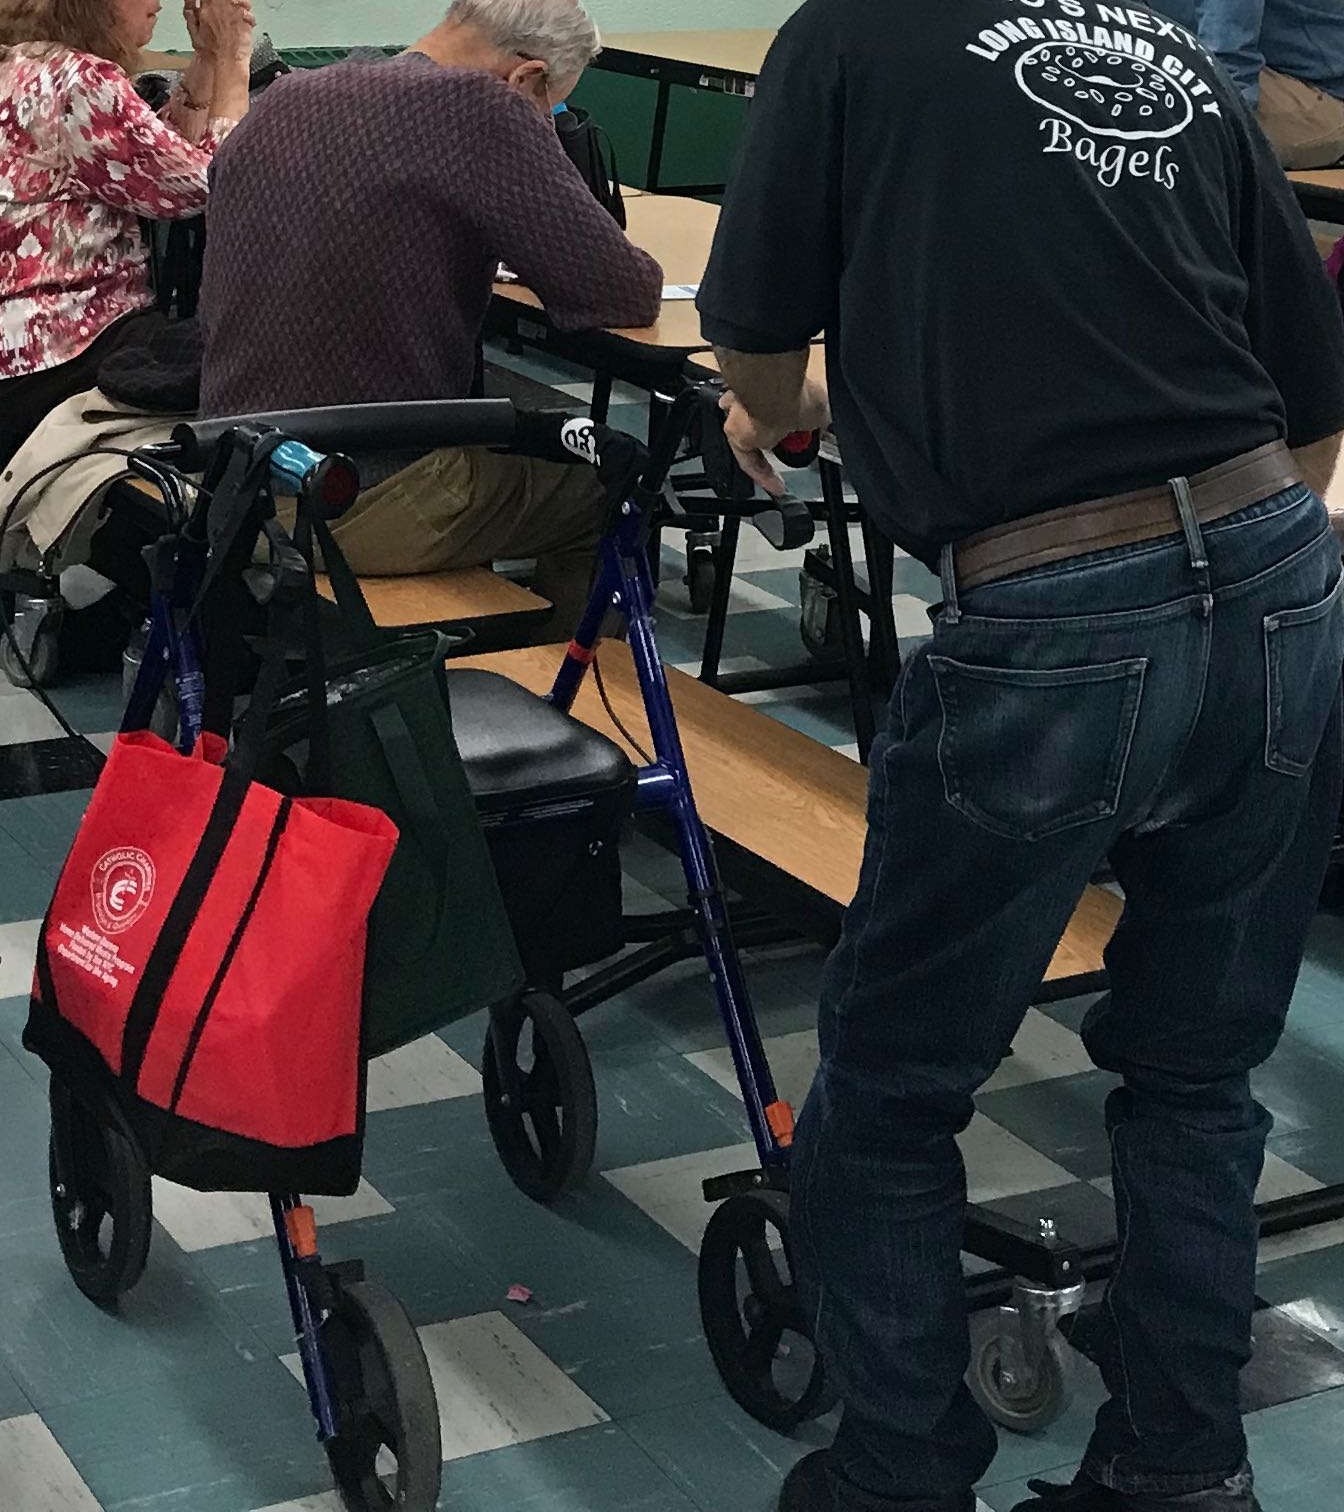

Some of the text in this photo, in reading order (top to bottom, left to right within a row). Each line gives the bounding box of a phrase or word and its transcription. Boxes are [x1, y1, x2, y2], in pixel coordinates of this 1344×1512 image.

[965, 16, 1223, 119] LONG ISLAND CITY
[1039, 117, 1180, 190] Bagels
